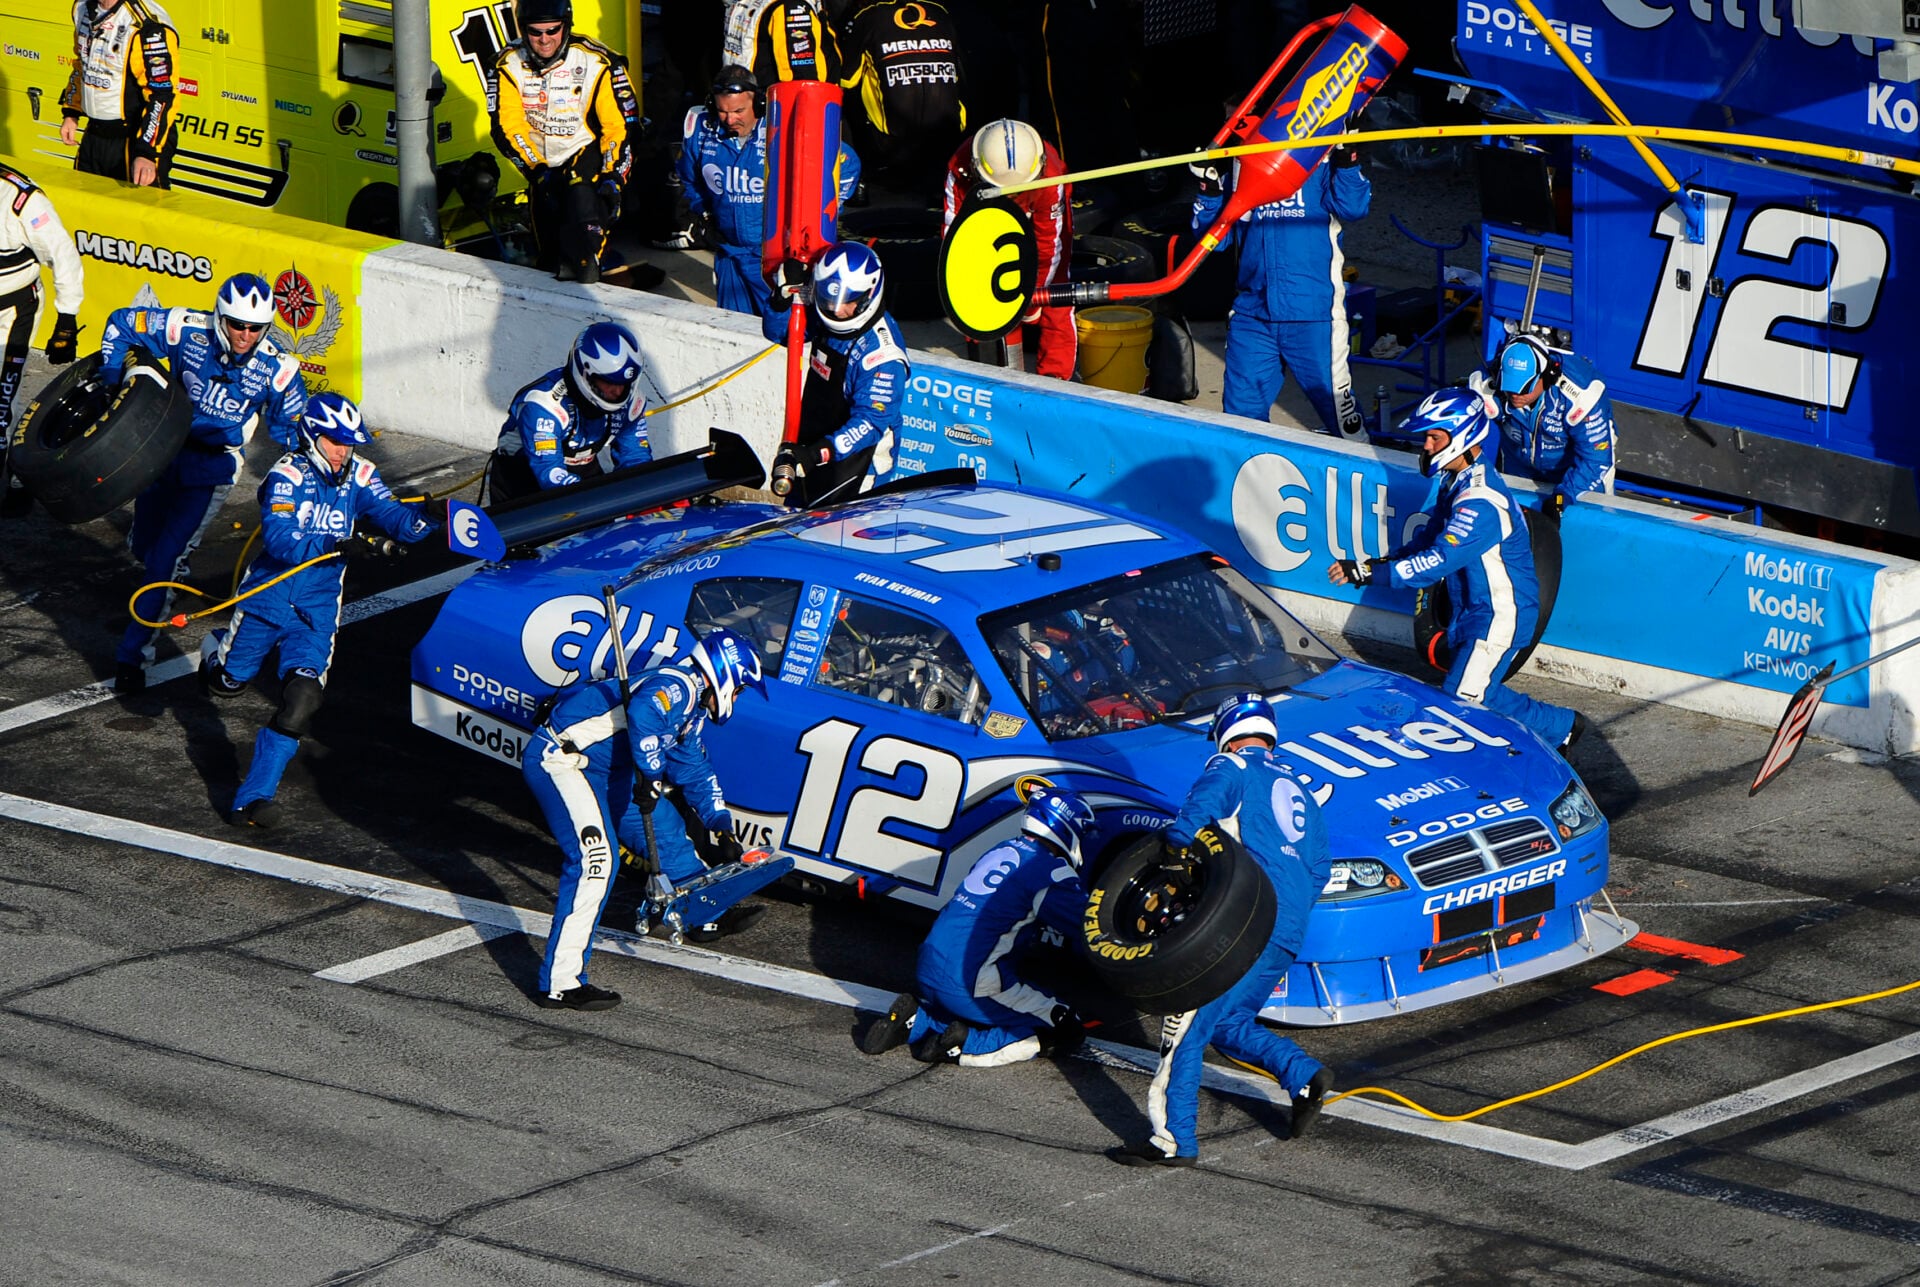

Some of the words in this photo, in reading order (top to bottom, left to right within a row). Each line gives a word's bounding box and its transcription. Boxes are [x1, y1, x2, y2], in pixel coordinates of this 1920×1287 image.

[15, 47, 40, 61] MOEN
[882, 39, 953, 54] MENARDS
[221, 90, 258, 105] SYLVANIA
[275, 99, 312, 117] NIBCO
[1290, 47, 1368, 140] SUNOCO
[332, 101, 366, 138] Q
[235, 126, 265, 149] SS
[1257, 207, 1306, 220] wireless
[76, 231, 213, 282] MENARDS
[1632, 184, 1889, 412] 12
[905, 376, 994, 408] ODGE
[902, 414, 937, 433] BOSCH
[1337, 382, 1362, 435] alltel
[834, 420, 874, 453] alltel
[644, 555, 721, 582] KENWOOD
[1395, 549, 1445, 581] alltel
[1745, 551, 1807, 586] Mobil
[854, 572, 889, 587] RYAN
[886, 582, 942, 604] NEWMAN
[1748, 587, 1825, 627] Kodak
[796, 643, 817, 654] BOSCH
[1764, 627, 1812, 655] AVIS
[1744, 651, 1823, 682] KENWOO
[453, 664, 536, 712] DODGE
[459, 683, 528, 719] DEALERS
[787, 717, 963, 894] 12
[1376, 780, 1446, 812] Mobil
[1385, 797, 1530, 848] DODGE
[580, 825, 607, 881] alltel
[1422, 859, 1567, 915] CHARGER
